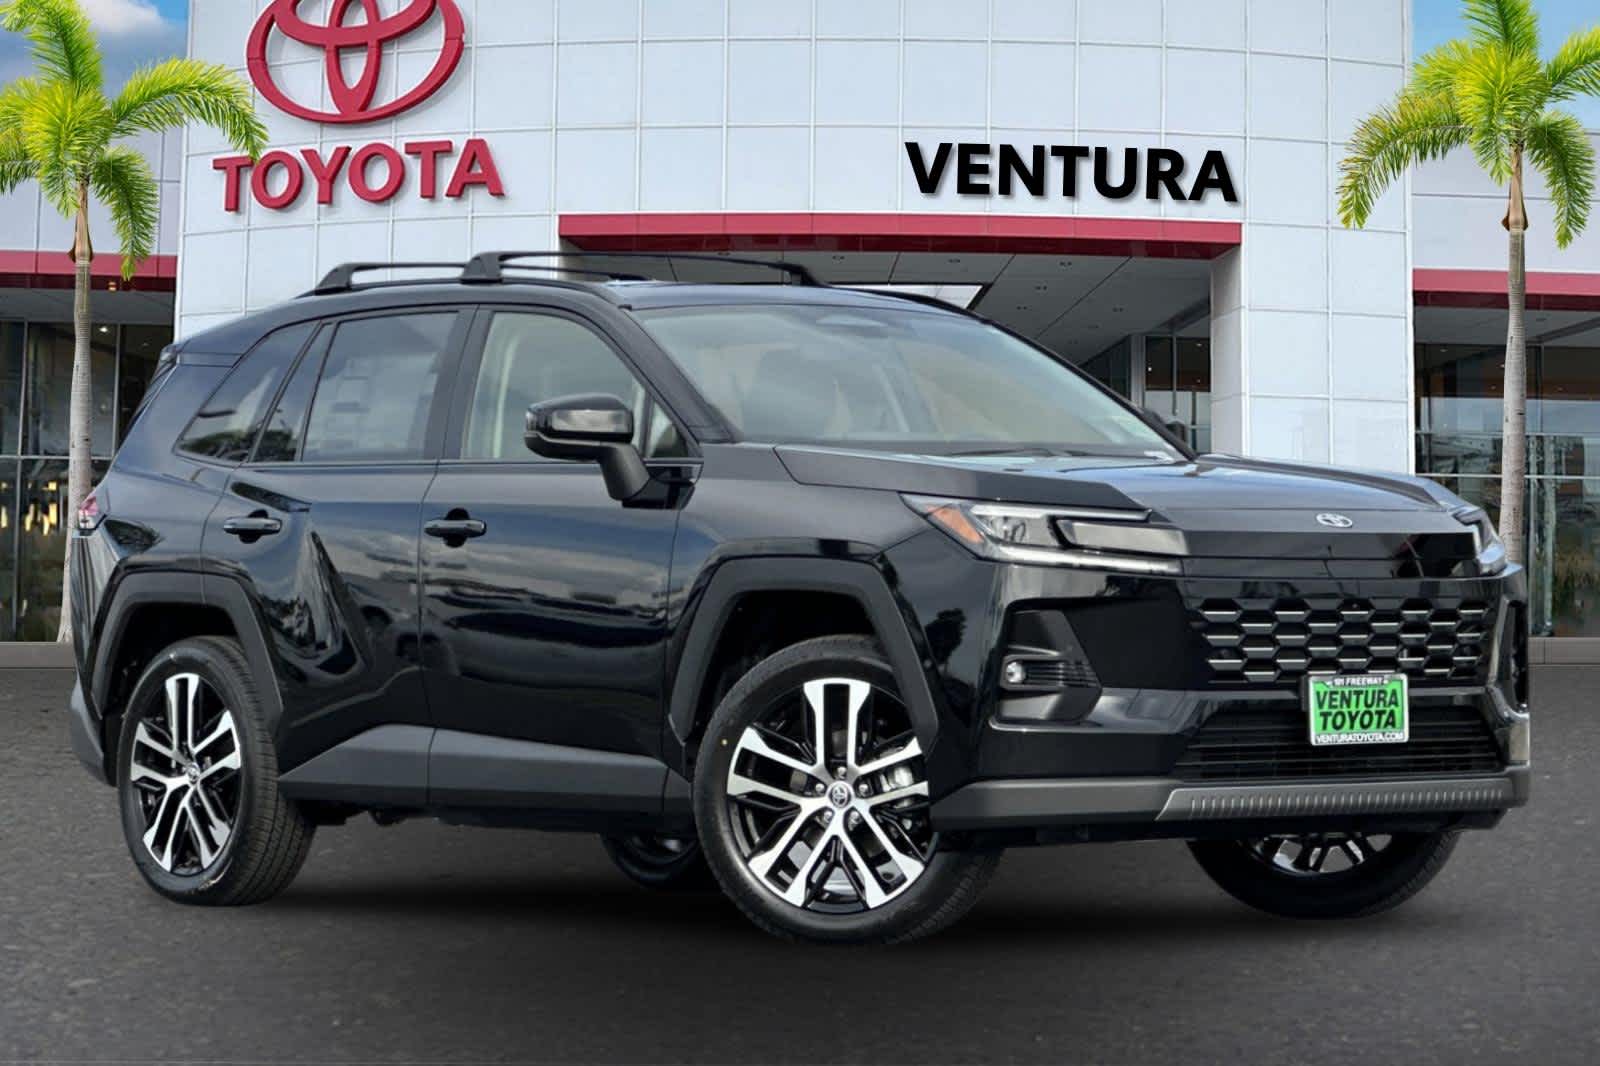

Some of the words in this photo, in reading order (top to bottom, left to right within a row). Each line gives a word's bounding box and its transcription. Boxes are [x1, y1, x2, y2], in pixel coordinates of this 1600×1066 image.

[212, 138, 505, 212] TOYOTA
[904, 141, 1239, 203] VENTURA
[1315, 688, 1399, 710] VENTURA
[1319, 709, 1397, 731] TOYOTA
